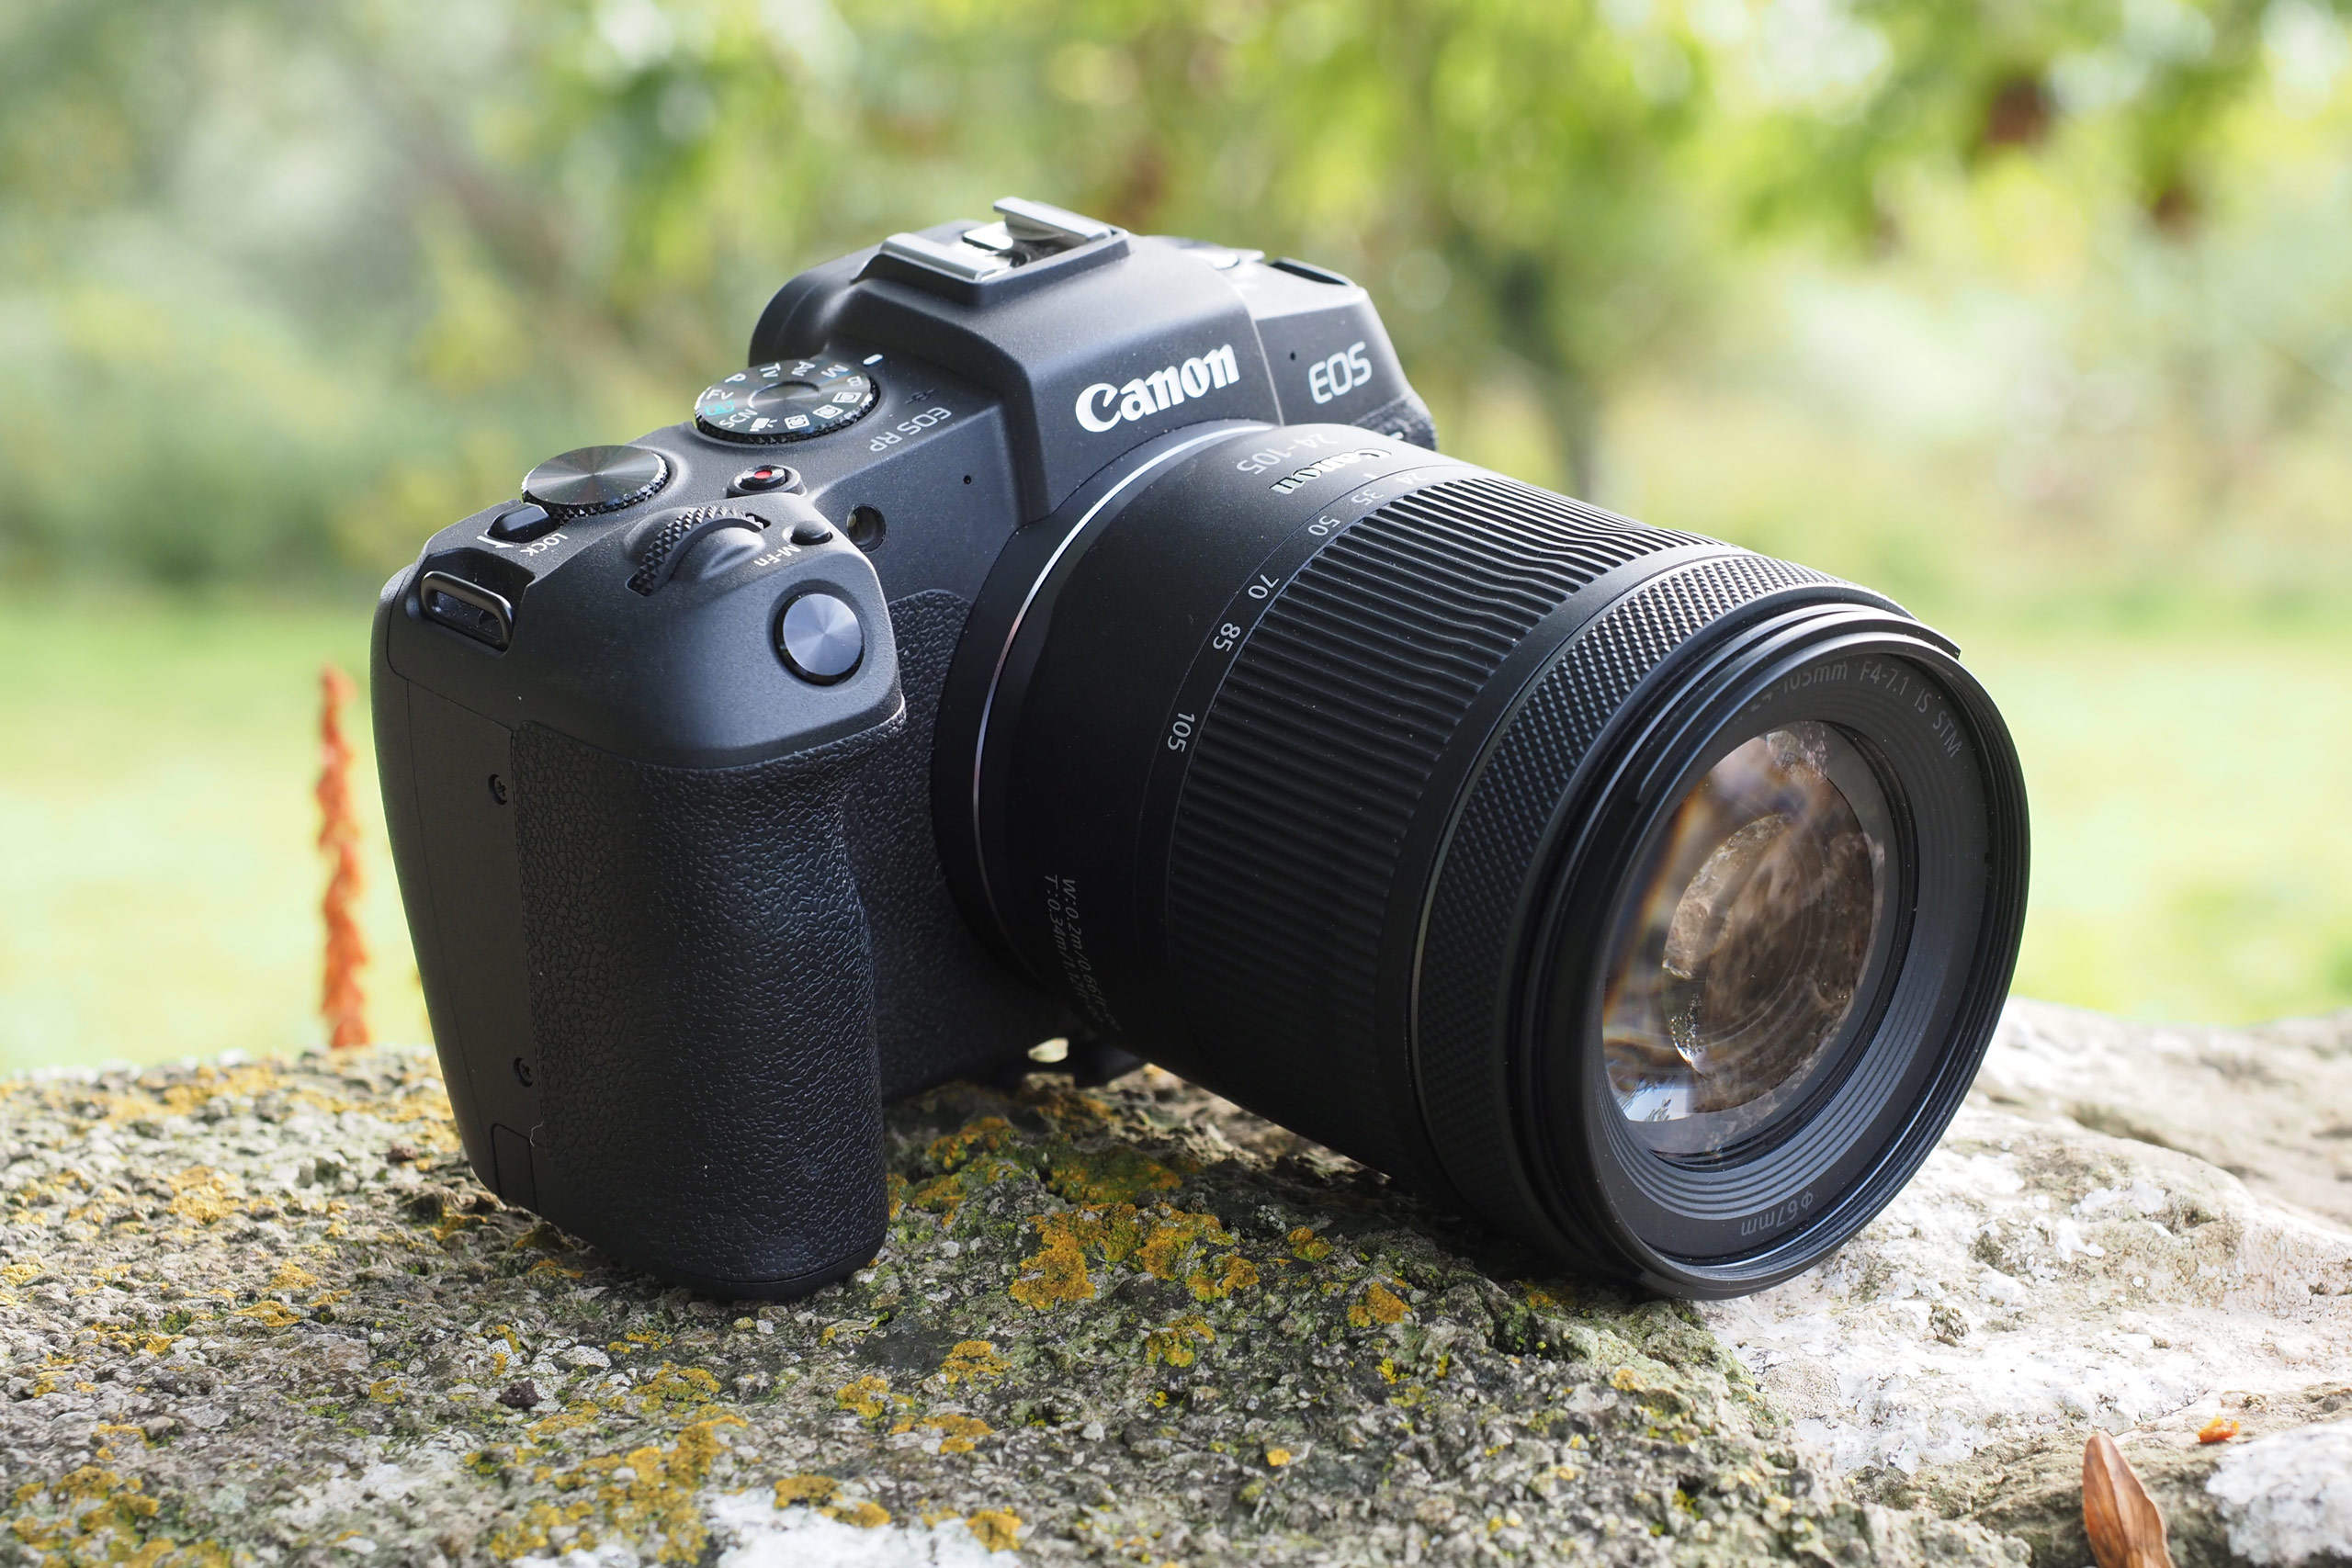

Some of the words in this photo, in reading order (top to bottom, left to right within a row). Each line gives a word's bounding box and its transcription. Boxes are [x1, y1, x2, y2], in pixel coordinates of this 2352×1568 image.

[725, 373, 746, 384] P
[760, 363, 781, 378] Tv
[791, 360, 816, 377] Av
[820, 364, 849, 378] M
[1308, 341, 1373, 405] EOS
[847, 376, 864, 387] B
[1075, 344, 1240, 433] Canon
[706, 389, 734, 400] Fv
[718, 409, 758, 428] SCN
[897, 407, 952, 434] EOS
[869, 431, 903, 452] RP
[1237, 433, 1340, 475] 24-105
[1268, 448, 1392, 495] Canon
[1396, 471, 1429, 486] 24
[1351, 488, 1386, 507] 35
[1308, 515, 1341, 536] 50
[519, 532, 569, 557] LOCK
[753, 544, 801, 567] M-Fn
[1248, 574, 1280, 600] 70
[1212, 622, 1240, 651] 85
[1859, 661, 1909, 696] F4-7.1
[1914, 688, 1932, 714] IS
[1932, 710, 1962, 758] STM
[1167, 712, 1195, 752] 105
